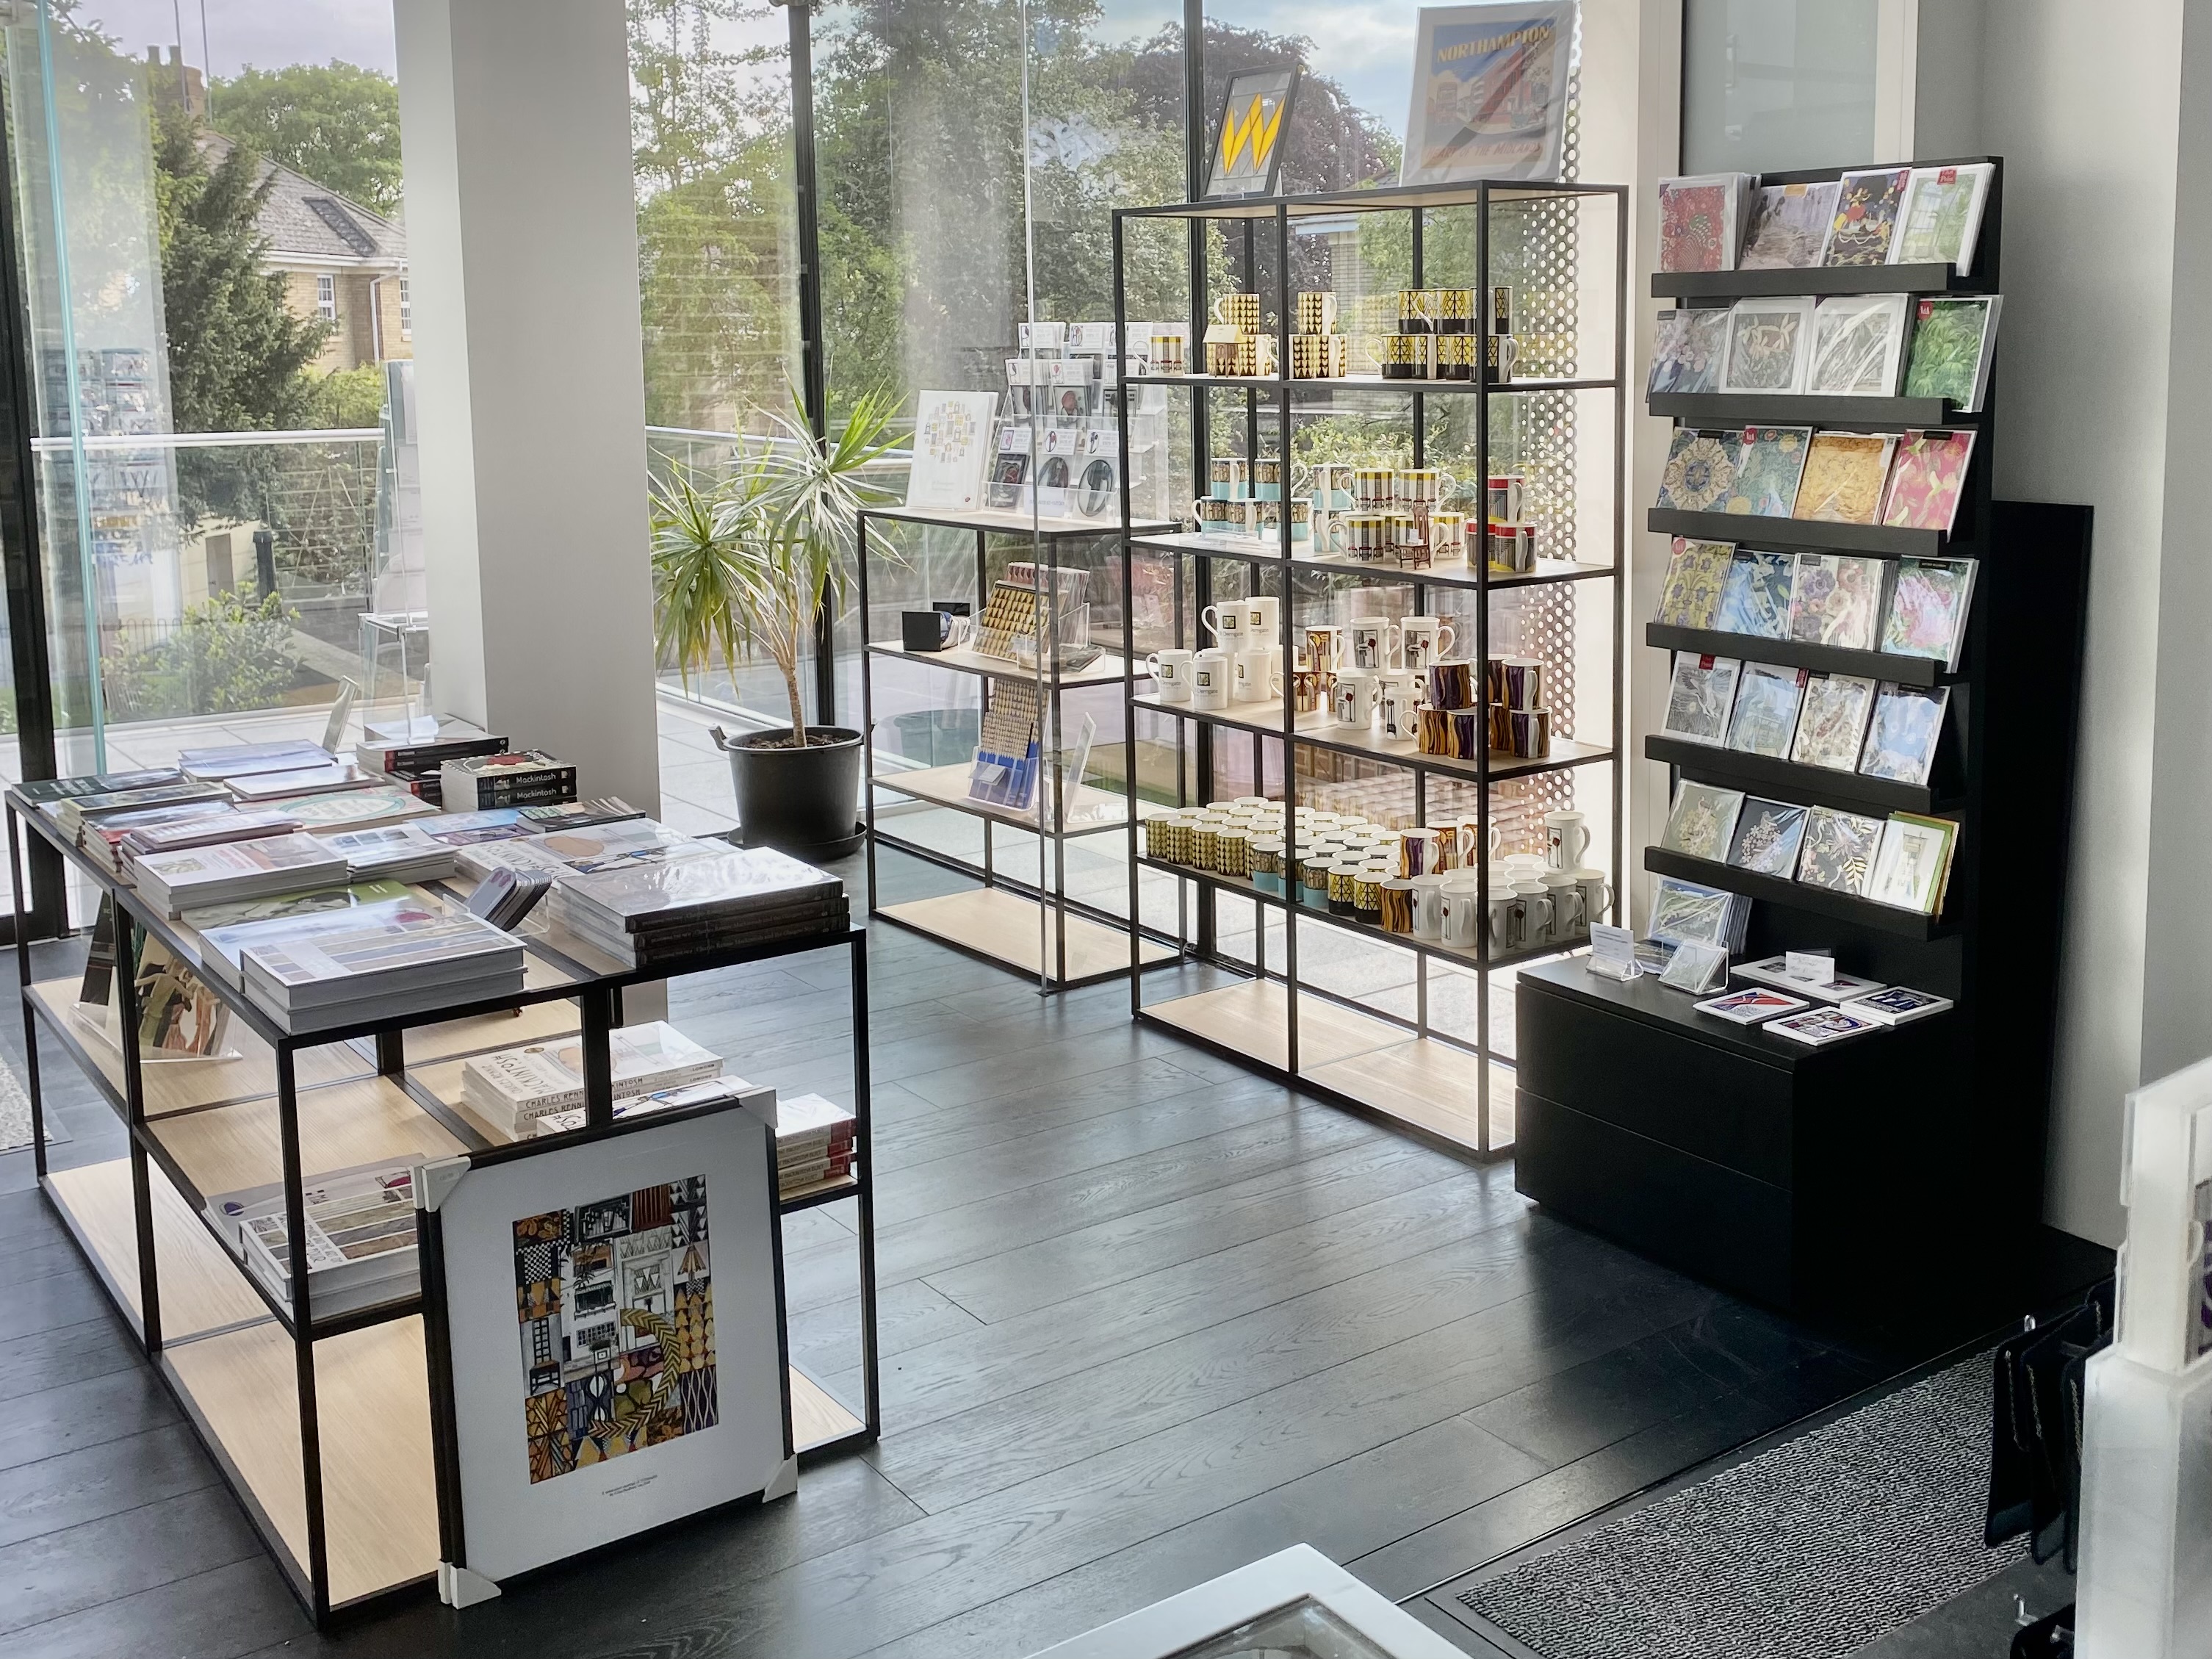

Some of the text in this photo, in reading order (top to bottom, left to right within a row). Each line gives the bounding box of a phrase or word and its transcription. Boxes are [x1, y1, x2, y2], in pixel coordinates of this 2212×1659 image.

[1436, 24, 1551, 63] NORTHAMPTON
[1474, 145, 1491, 156] THE
[1494, 141, 1541, 156] MIDLANDS
[516, 773, 556, 785] Mackintosh
[516, 788, 557, 799] Mackintosh
[524, 1089, 641, 1120] CHARLES RENNI INTOSH
[526, 1094, 561, 1109] CHARLES
[563, 1090, 584, 1101] RENN
